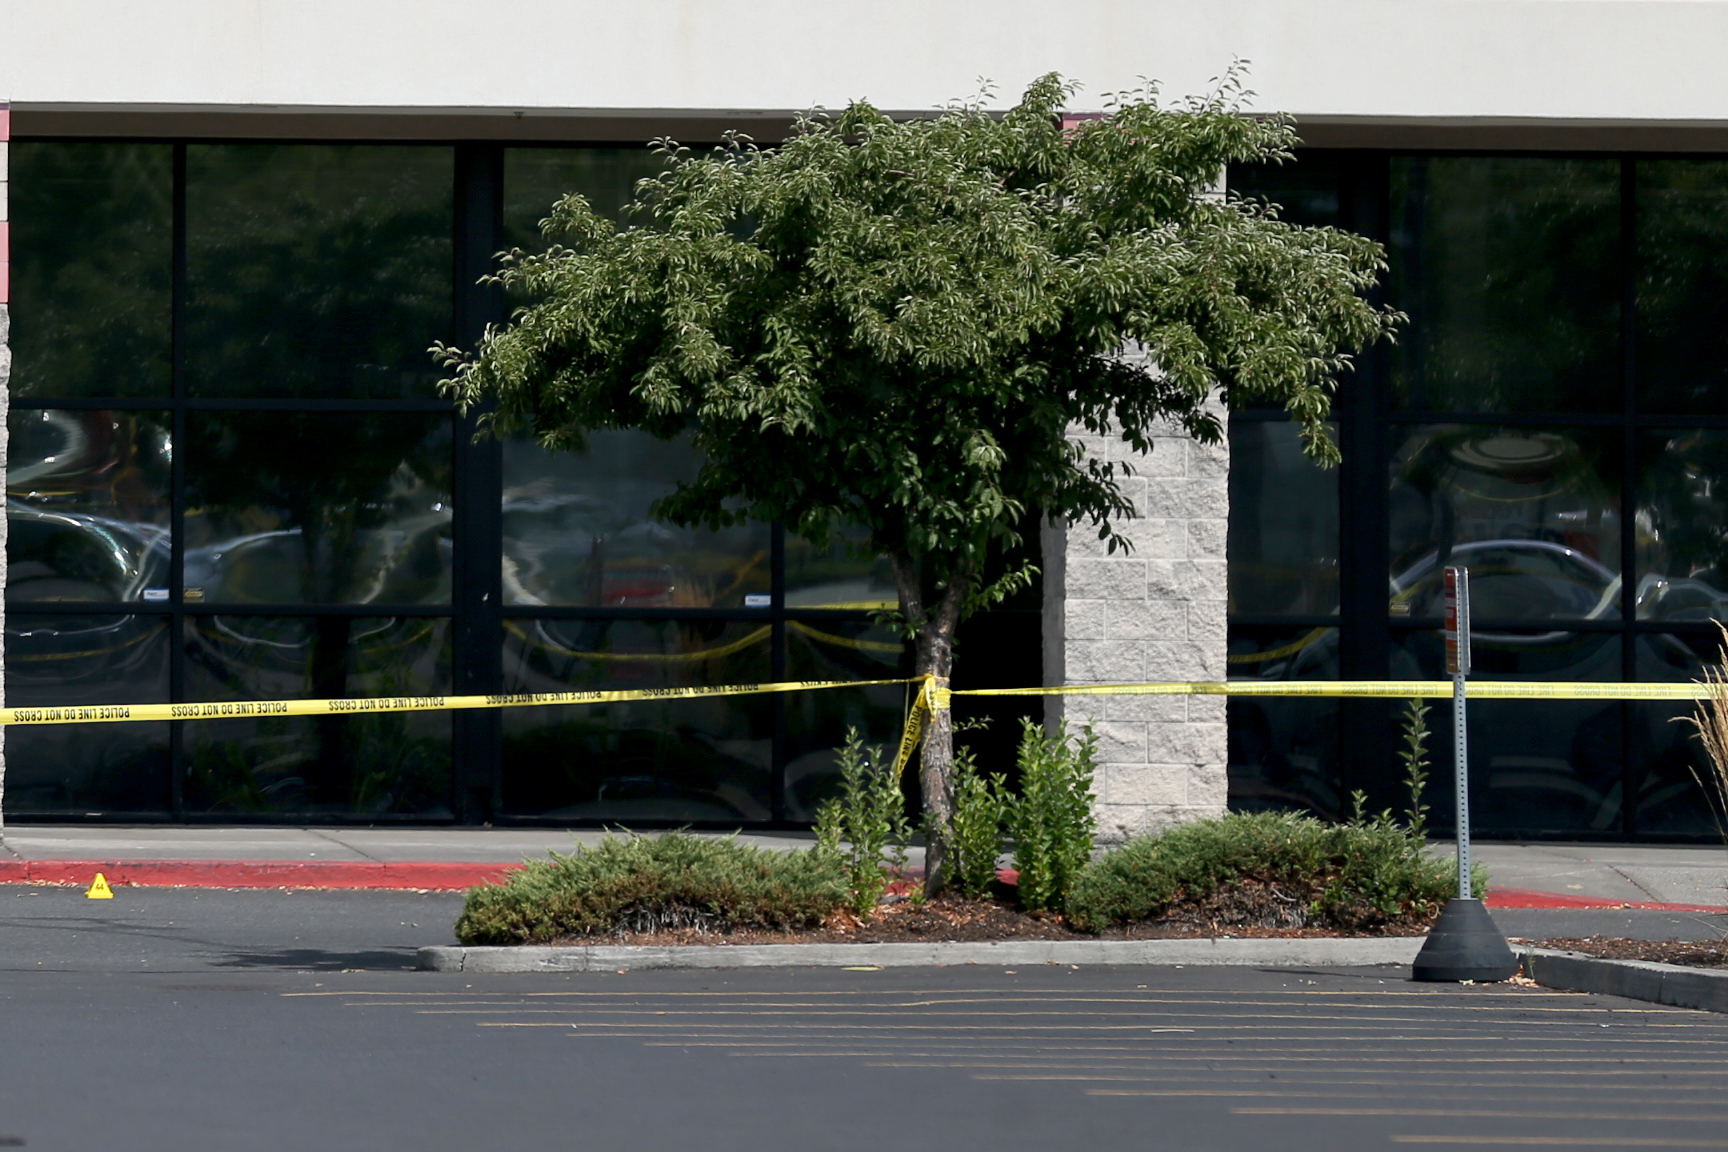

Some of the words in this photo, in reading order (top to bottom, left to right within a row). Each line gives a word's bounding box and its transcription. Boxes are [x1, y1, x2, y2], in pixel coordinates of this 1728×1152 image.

[329, 701, 357, 712] CROSS
[359, 699, 376, 711] NOT
[379, 699, 390, 710] DO
[393, 698, 412, 710] LINE
[414, 696, 445, 708] POLICE
[78, 708, 97, 721] LINE
[99, 707, 130, 720] POLICE
[171, 705, 200, 717] CROSS
[202, 705, 219, 717] NOT
[221, 704, 233, 716] DO
[236, 703, 255, 716] LINE
[257, 702, 288, 715] POLICE
[14, 710, 43, 723] CROSS
[44, 710, 62, 722] NOT
[64, 709, 76, 722] DO
[906, 705, 922, 735] POLICE
[95, 882, 104, 891] 44
